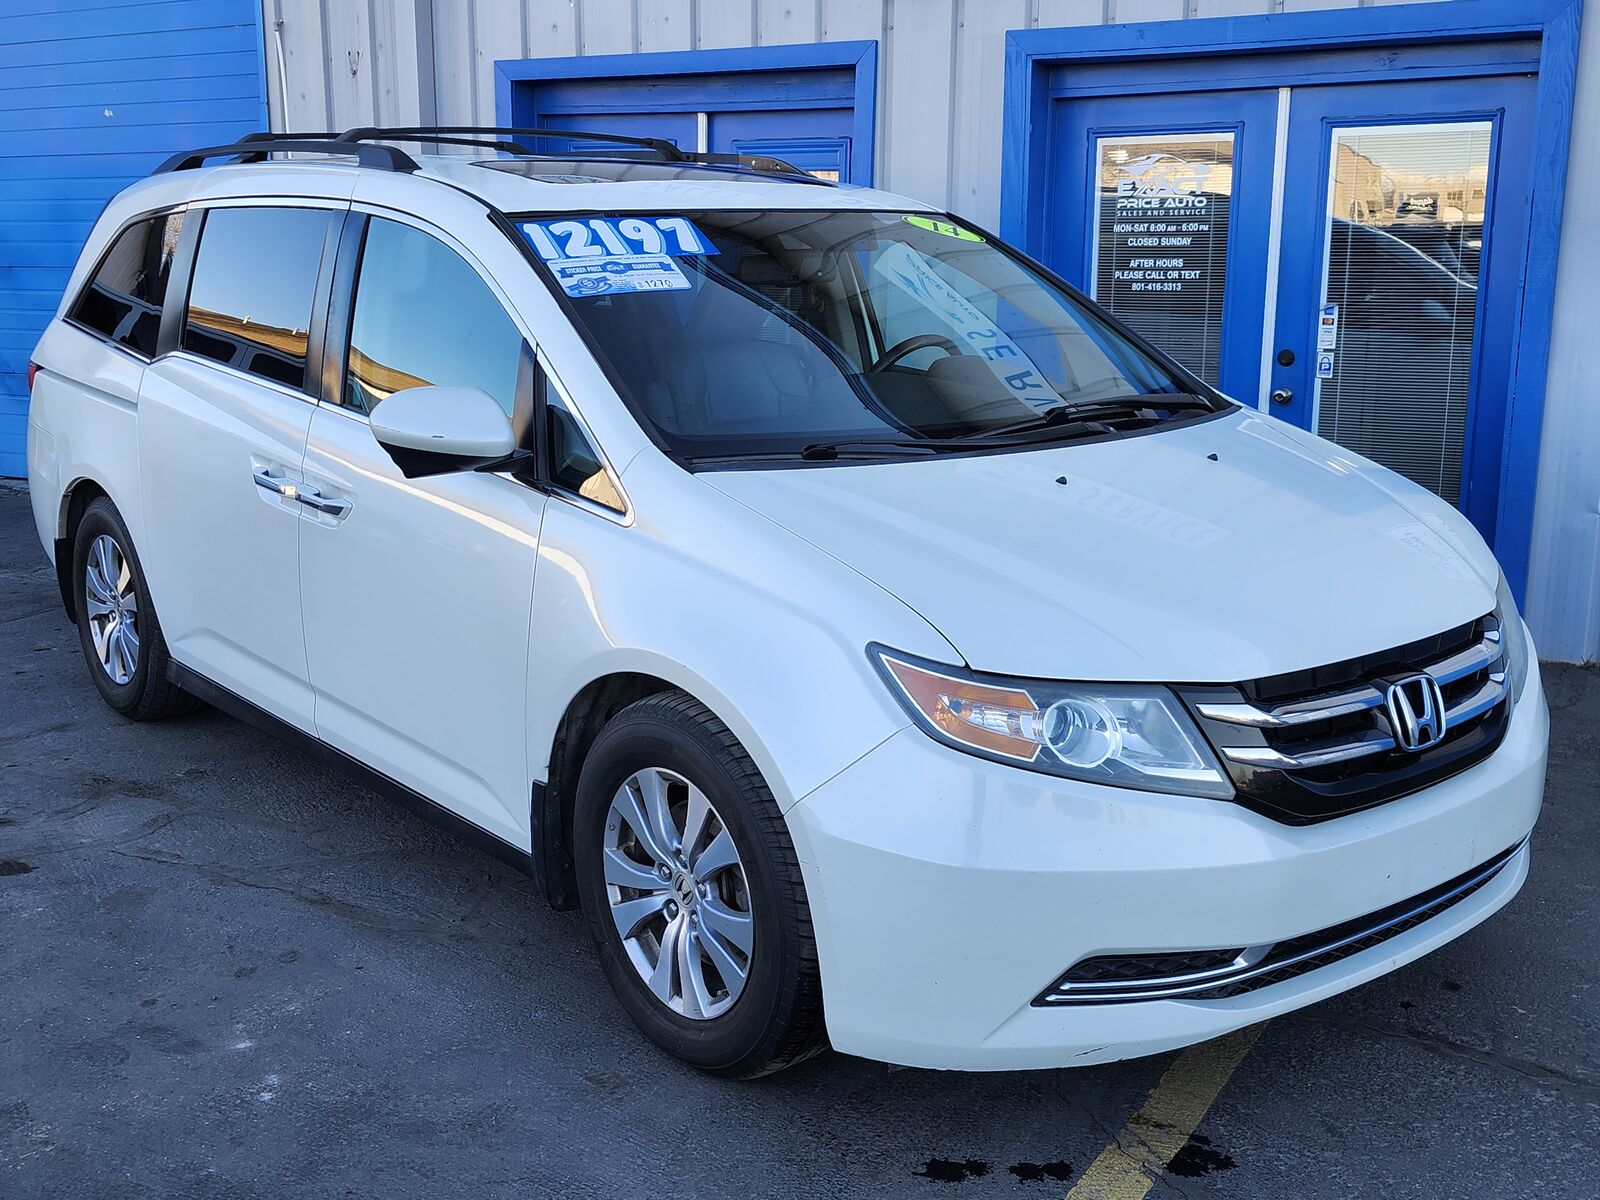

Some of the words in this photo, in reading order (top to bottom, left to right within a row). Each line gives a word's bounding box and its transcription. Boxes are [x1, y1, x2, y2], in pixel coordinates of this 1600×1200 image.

[1117, 175, 1209, 196] EXACT
[1117, 198, 1160, 209] PRICE
[1163, 197, 1207, 208] AUTO
[932, 221, 960, 237] 14
[1113, 224, 1149, 233] MON-SAT
[1149, 223, 1166, 232] 8:00
[523, 218, 705, 260] 12197
[1128, 238, 1159, 246] CLOSED
[1160, 237, 1192, 246] SUNDAY
[1129, 259, 1154, 268] AFTER
[1155, 259, 1184, 267] HOURS
[1114, 271, 1144, 279] PLEASE
[1145, 271, 1165, 279] CALL
[1166, 271, 1180, 279] OR
[1181, 270, 1201, 279] TEXT
